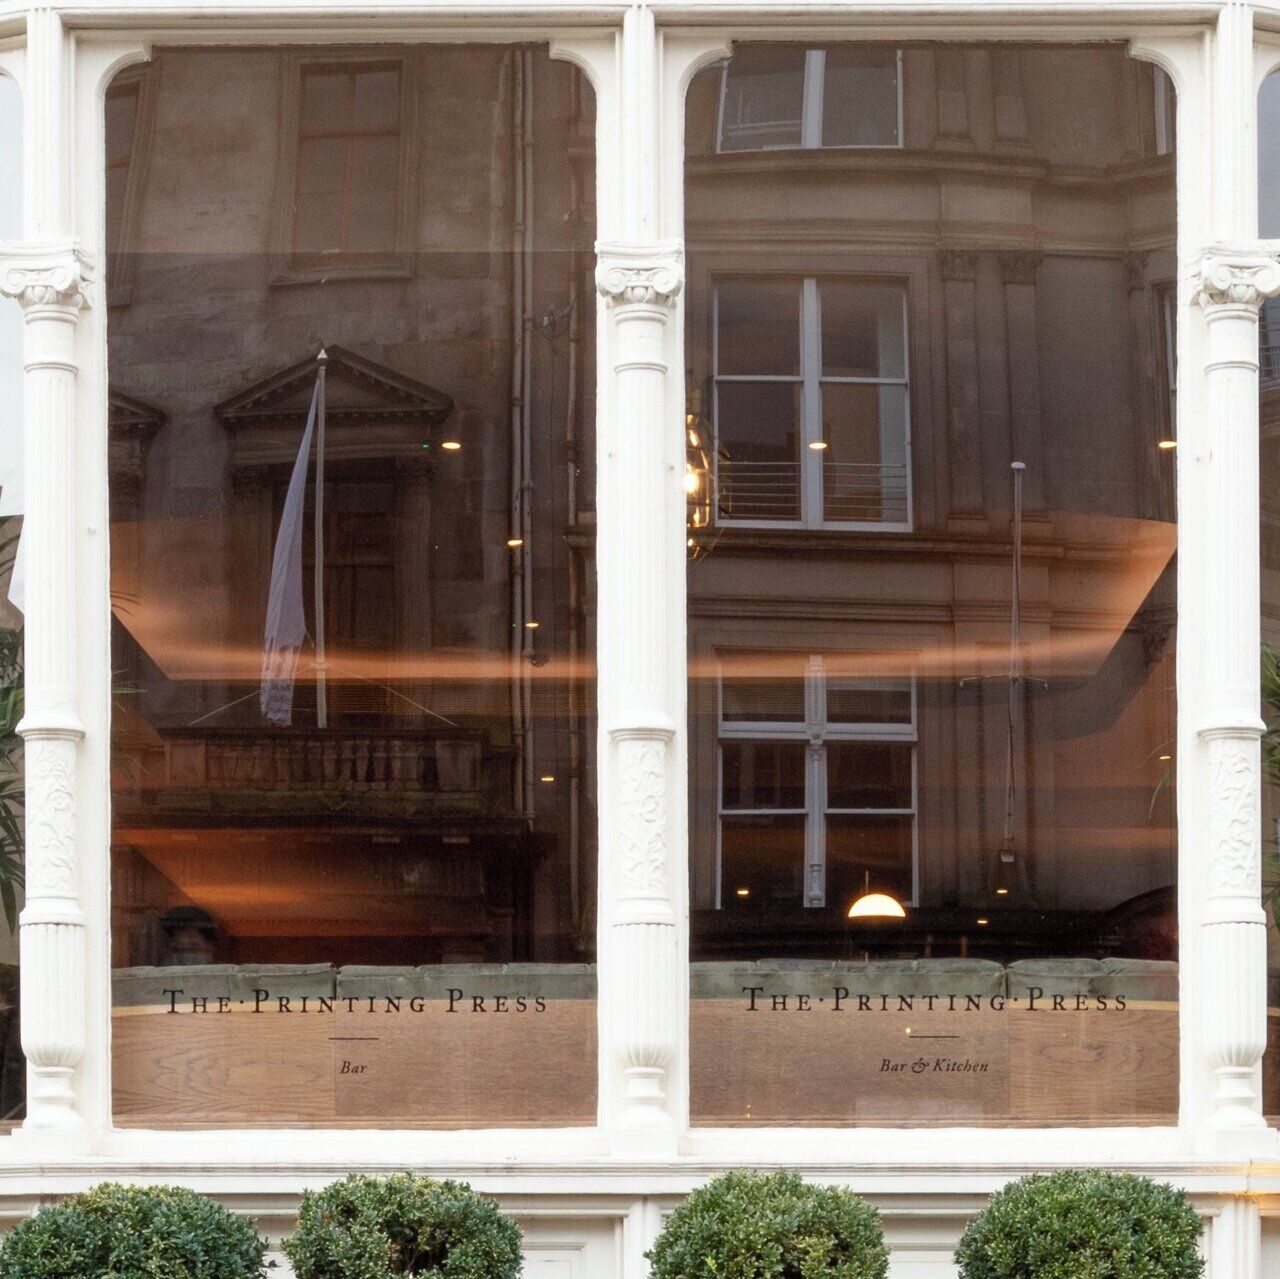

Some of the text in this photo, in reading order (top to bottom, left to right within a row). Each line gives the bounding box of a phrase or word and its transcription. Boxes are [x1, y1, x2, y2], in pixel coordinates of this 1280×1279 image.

[340, 1061, 367, 1074] Bar
[880, 1058, 989, 1074] Bar & Kitchen
